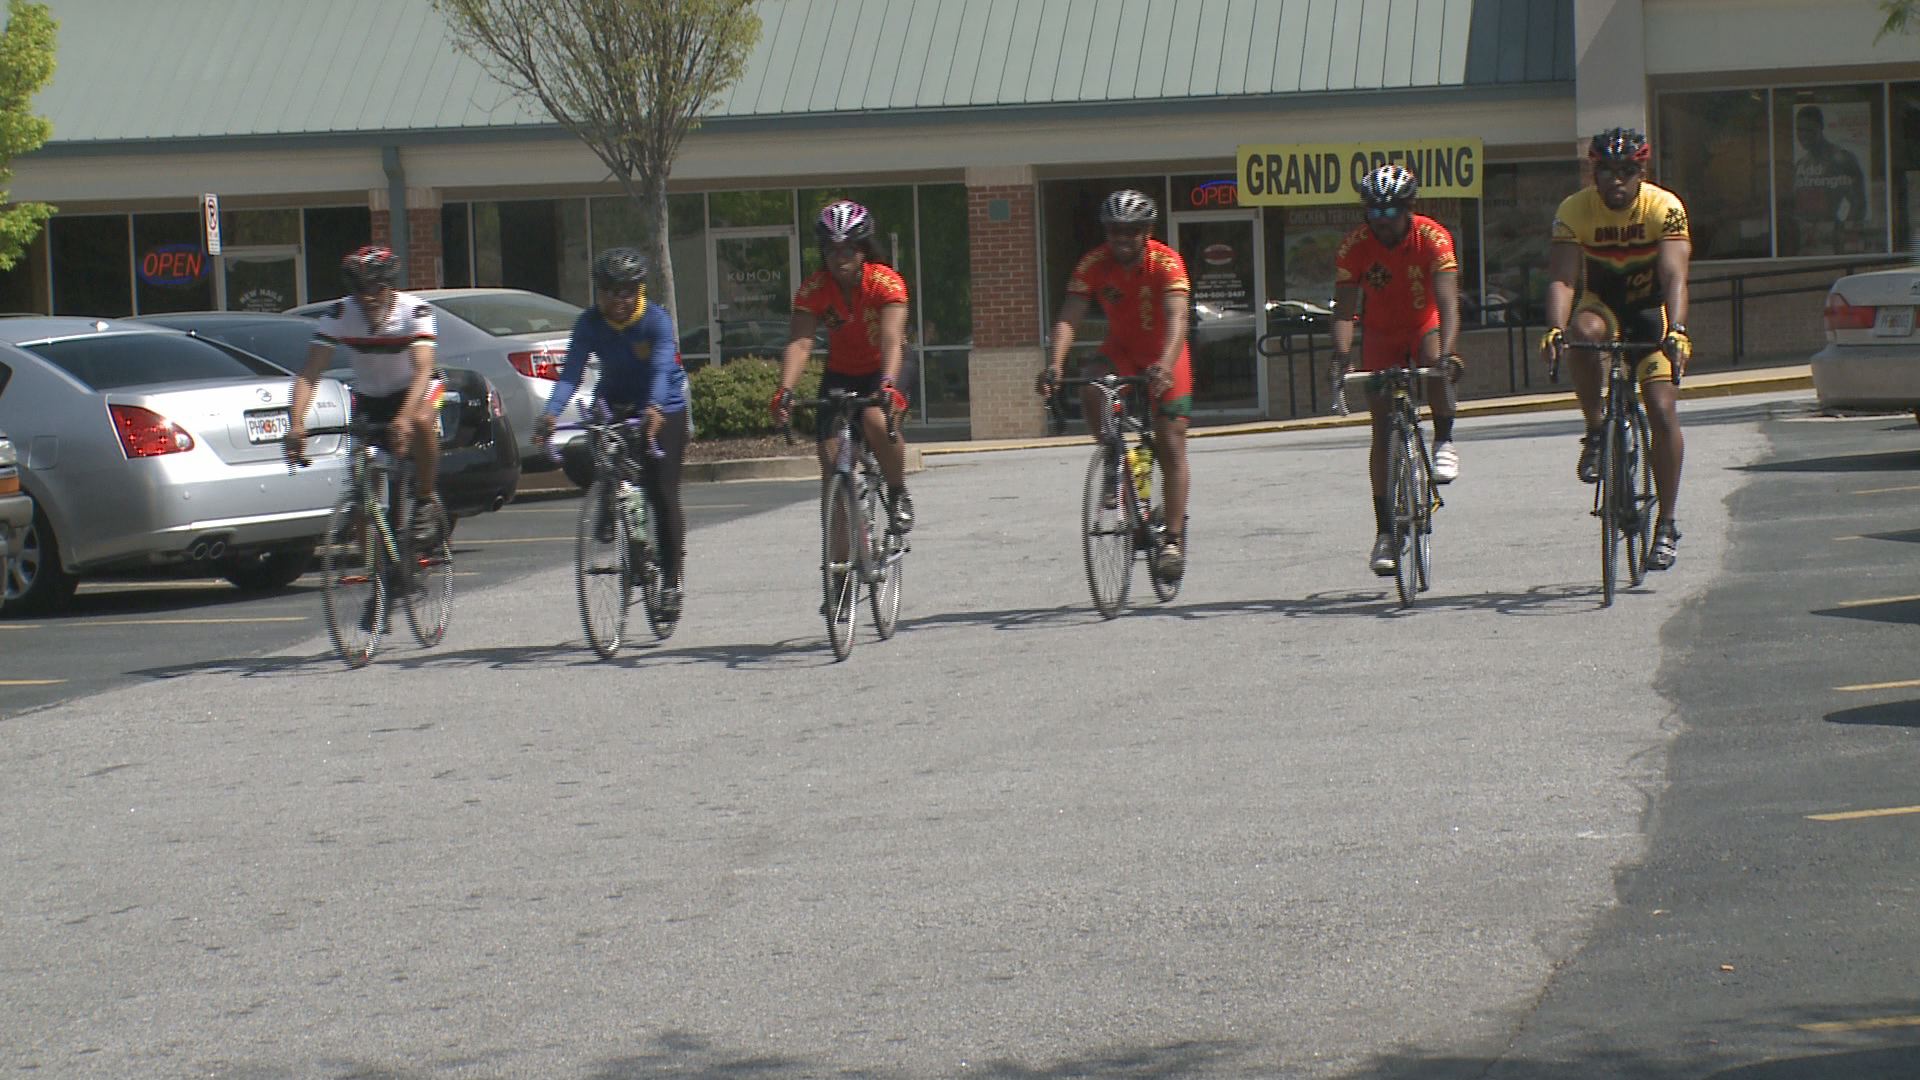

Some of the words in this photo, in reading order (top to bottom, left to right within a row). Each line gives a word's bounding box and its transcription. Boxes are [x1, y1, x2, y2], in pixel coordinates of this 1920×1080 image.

[1246, 152, 1341, 196] GRAND
[1351, 147, 1474, 194] ONING
[1191, 185, 1238, 206] OPEN
[143, 252, 203, 278] OPEN
[727, 269, 781, 282] KUMON
